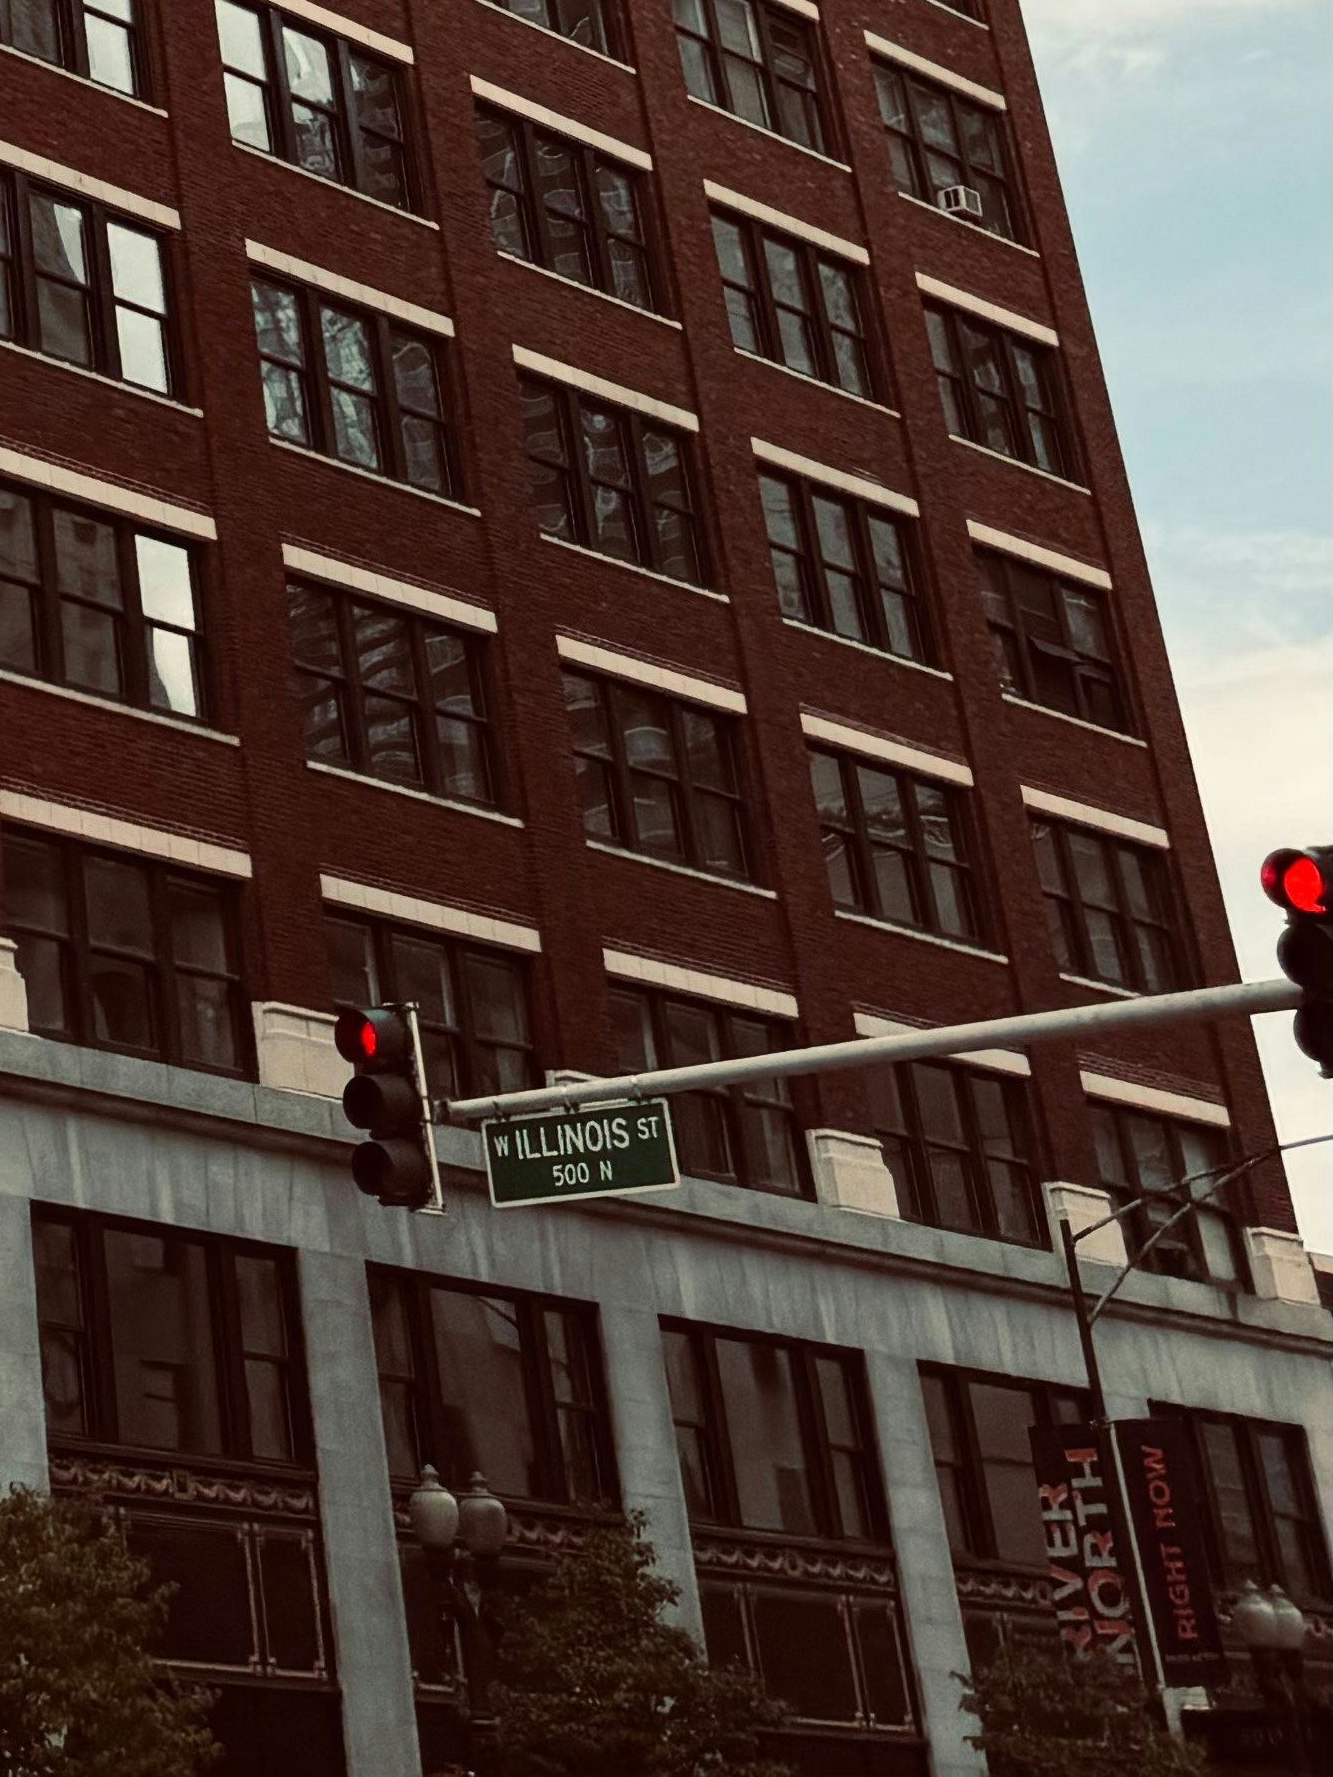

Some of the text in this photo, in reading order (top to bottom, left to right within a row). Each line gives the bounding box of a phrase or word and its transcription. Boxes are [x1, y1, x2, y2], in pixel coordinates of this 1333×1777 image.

[494, 1117, 659, 1160] W ILLINOIS ST
[553, 1160, 613, 1186] 500 N
[1141, 1445, 1176, 1529] NOW
[1160, 1542, 1198, 1640] RIGHT
